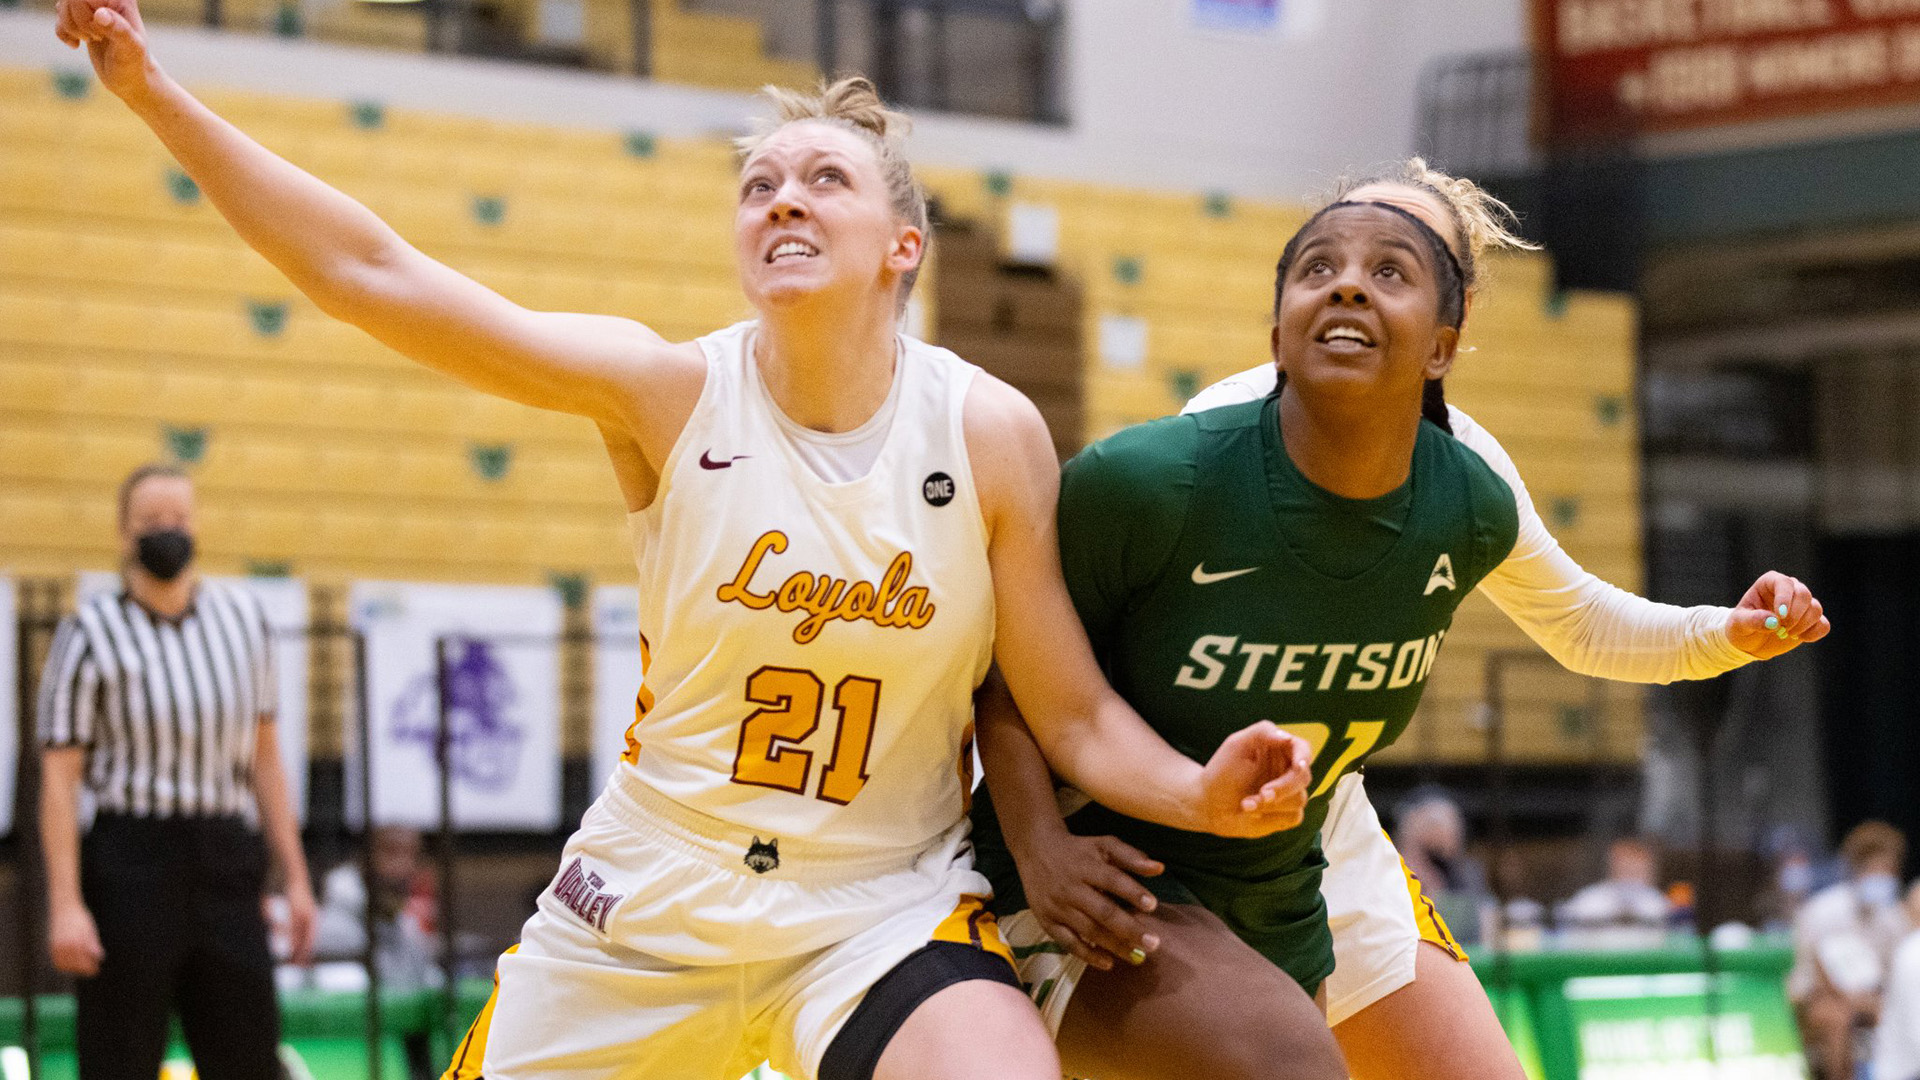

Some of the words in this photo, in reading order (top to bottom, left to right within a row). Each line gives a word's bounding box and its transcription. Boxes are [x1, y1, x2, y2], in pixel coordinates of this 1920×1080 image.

[925, 480, 952, 499] ONE
[717, 530, 935, 644] Loyola
[731, 665, 881, 806] 21
[552, 857, 624, 934] VALLEY
